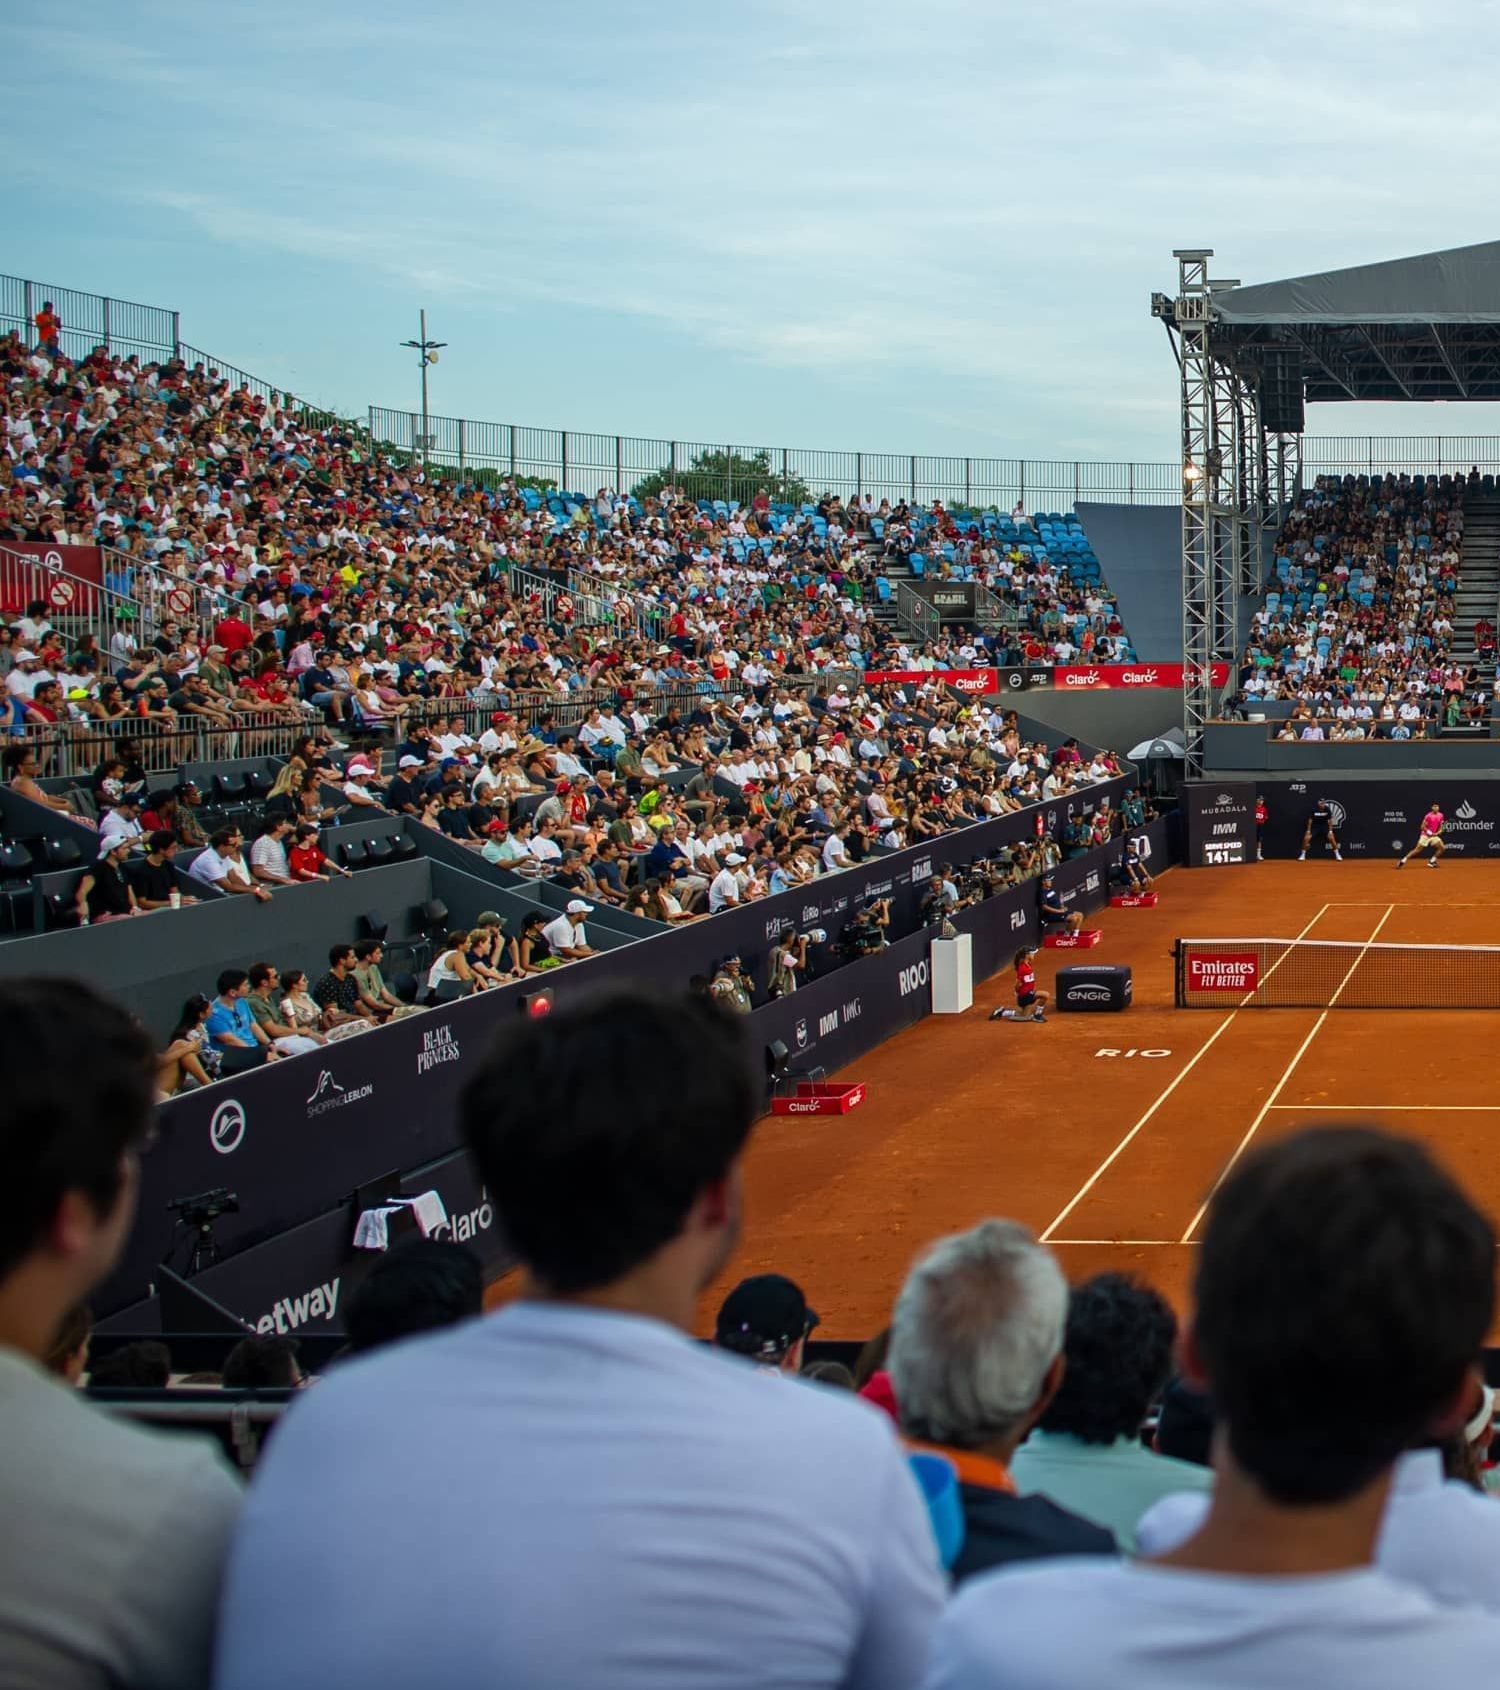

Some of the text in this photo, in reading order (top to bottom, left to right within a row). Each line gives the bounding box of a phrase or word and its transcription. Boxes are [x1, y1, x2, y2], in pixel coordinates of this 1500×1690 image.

[956, 676, 986, 689] Claro
[1066, 672, 1097, 685] Claro
[1122, 671, 1155, 683] Claro
[1201, 806, 1247, 815] MUBADALA
[1213, 823, 1237, 835] IMM
[1444, 820, 1494, 832] antander
[1206, 851, 1229, 864] 141
[1010, 909, 1026, 931] FILA
[1192, 960, 1255, 975] Emirates
[1201, 975, 1245, 987] FLY BETTER
[820, 1010, 838, 1037] IMM
[424, 1025, 452, 1051] BLACK
[1094, 1048, 1171, 1058] RIO
[789, 1101, 818, 1112] Claro
